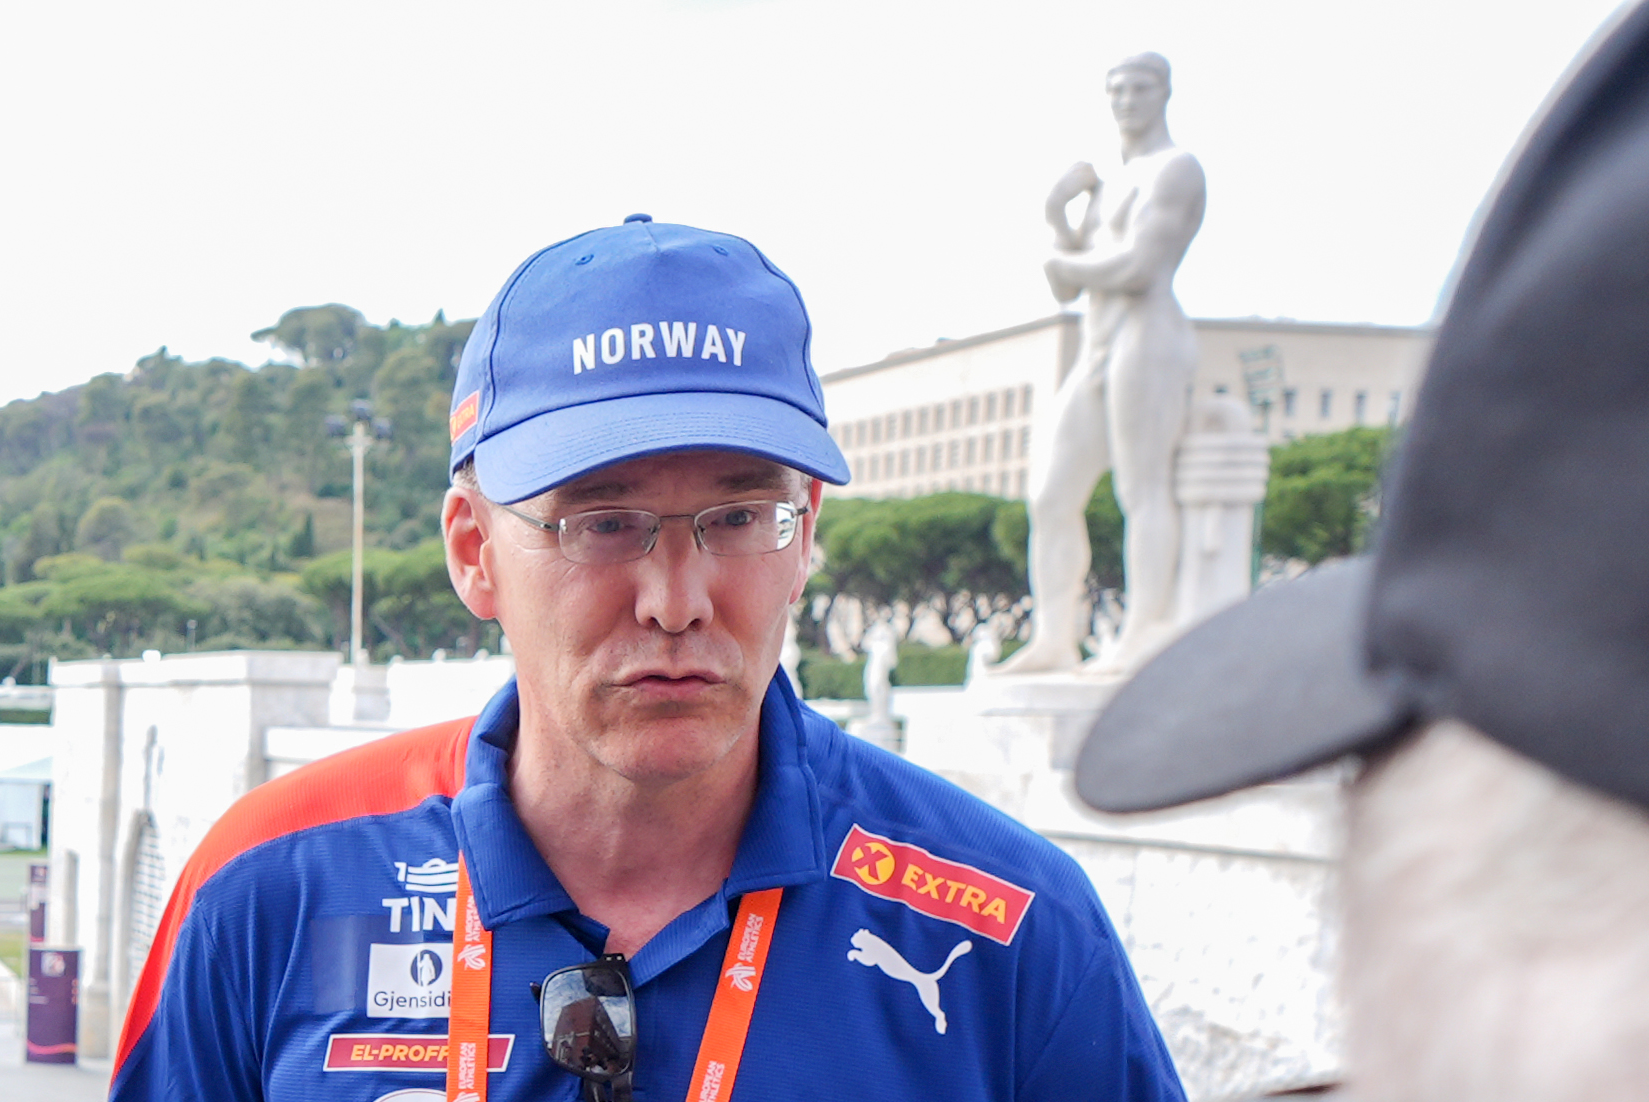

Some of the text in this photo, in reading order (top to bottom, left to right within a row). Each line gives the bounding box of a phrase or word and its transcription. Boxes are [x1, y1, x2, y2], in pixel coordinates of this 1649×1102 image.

[572, 321, 746, 375] NORWAY
[382, 896, 457, 933] TIN
[901, 863, 1007, 925] EXTRA
[737, 913, 757, 961] EUROPEAN
[745, 916, 764, 963] ATHLETICS
[374, 990, 452, 1011] Gjensidi
[351, 1044, 449, 1062] EL-PROFF
[458, 1042, 468, 1089] EUROPEAN
[466, 1042, 476, 1089] ATHLETICS
